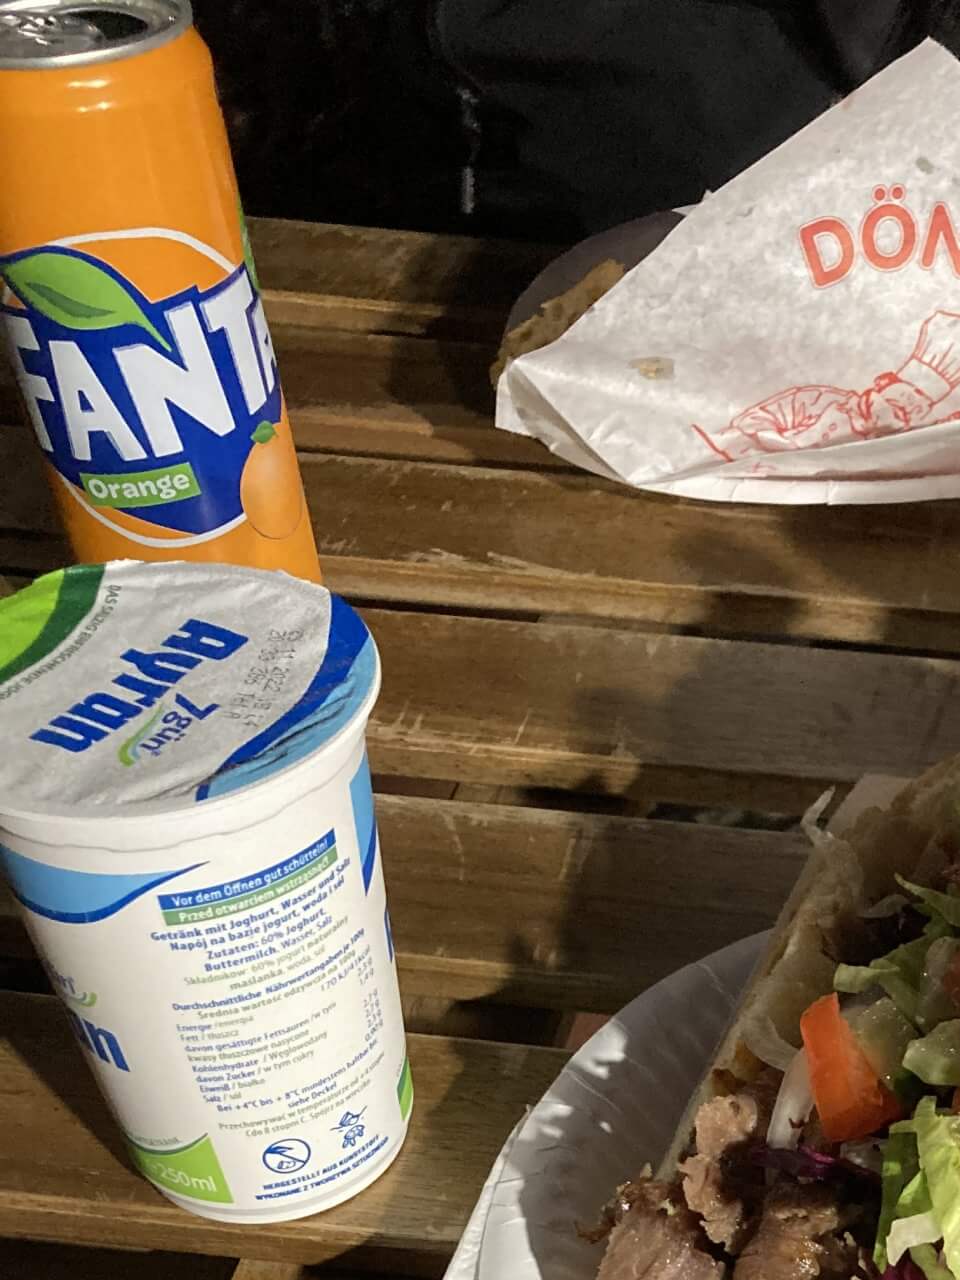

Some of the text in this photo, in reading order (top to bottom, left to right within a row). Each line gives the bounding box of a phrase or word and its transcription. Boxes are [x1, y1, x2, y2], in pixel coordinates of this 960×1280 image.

[87, 473, 190, 499] Orange
[172, 896, 193, 908] Vor
[196, 890, 222, 904] dem
[223, 877, 263, 897] Öffnen
[264, 869, 282, 884] gut
[151, 927, 202, 941] Getränk
[205, 923, 228, 936] mit
[230, 908, 279, 931] Joghurt,
[280, 886, 317, 910] Wasser
[318, 872, 337, 889] und
[179, 907, 214, 923] Przed
[210, 935, 226, 946] na
[228, 925, 260, 942] bazie
[302, 893, 328, 912] woda
[207, 940, 260, 961] Zutaten:
[260, 931, 284, 945] 60%
